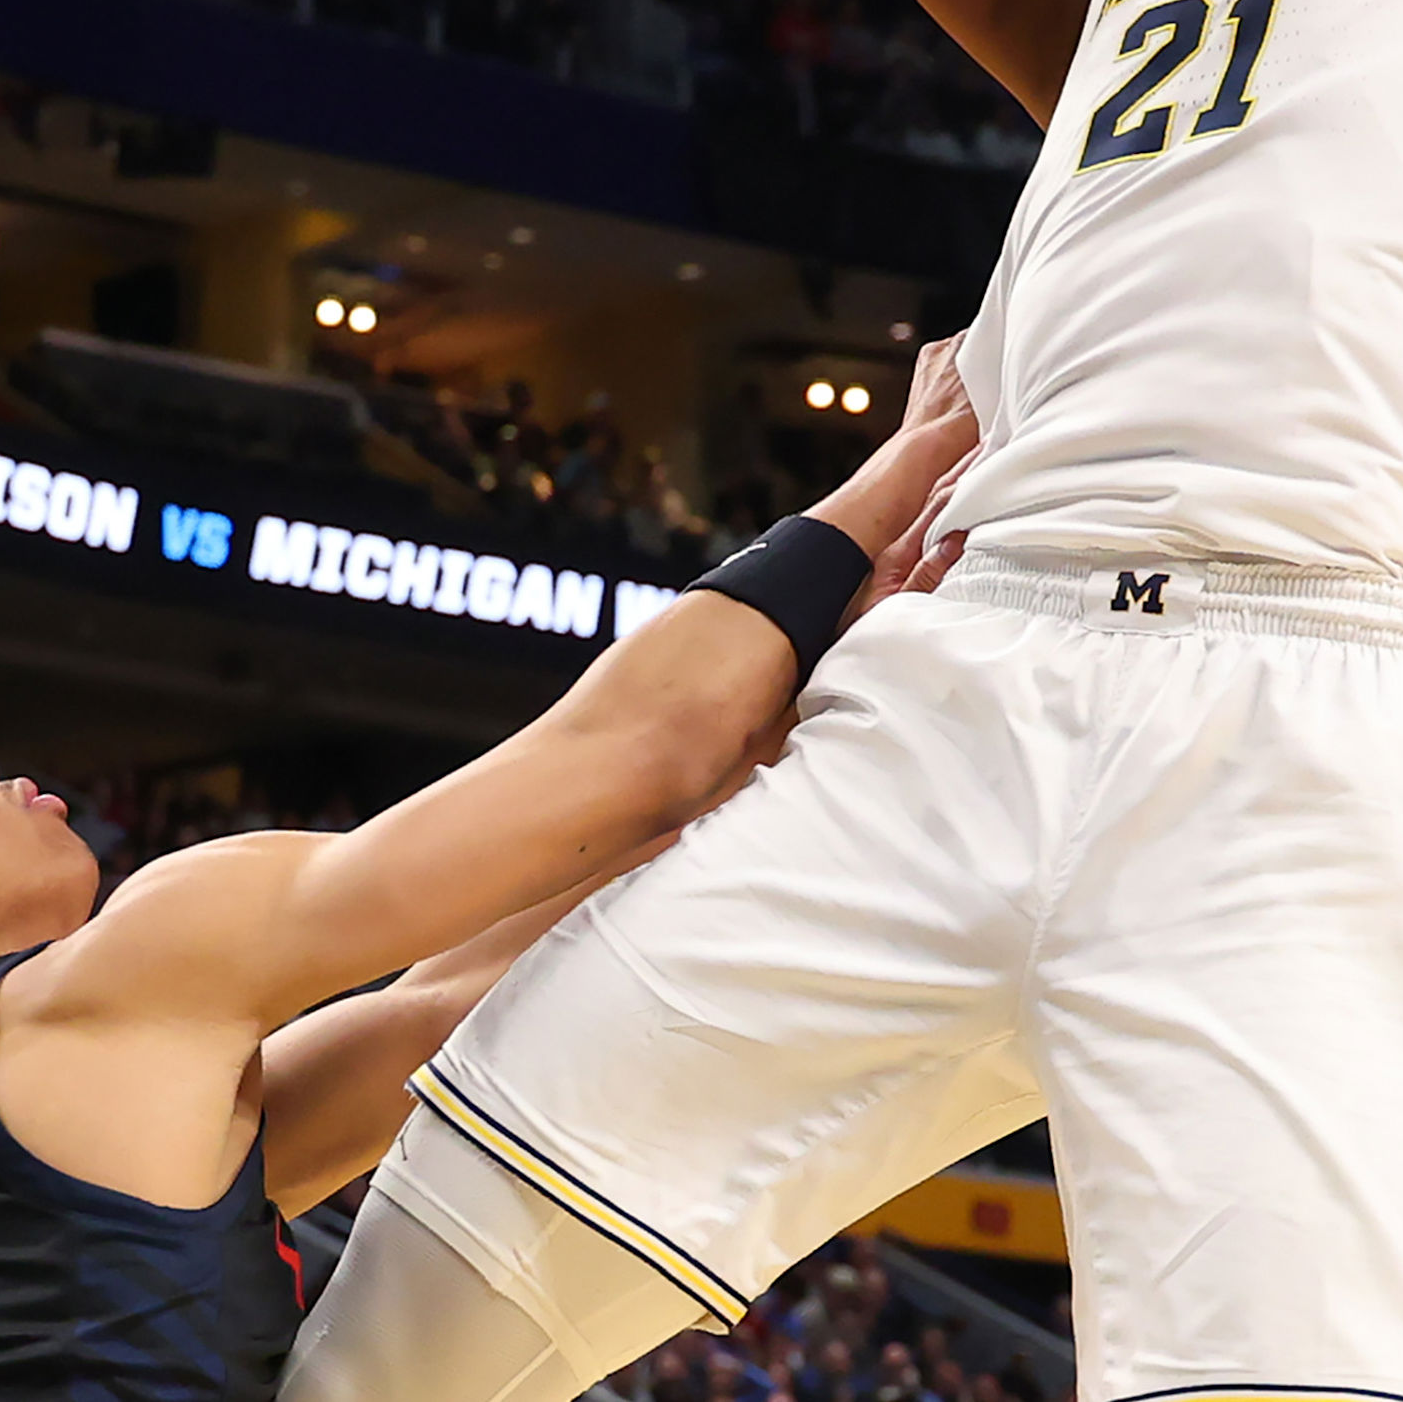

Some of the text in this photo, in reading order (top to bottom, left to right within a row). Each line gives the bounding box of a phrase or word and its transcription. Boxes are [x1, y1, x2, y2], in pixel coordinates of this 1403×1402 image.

[160, 502, 234, 570] VS
[248, 514, 604, 638] MICHIGAN
[1110, 570, 1171, 615] M
